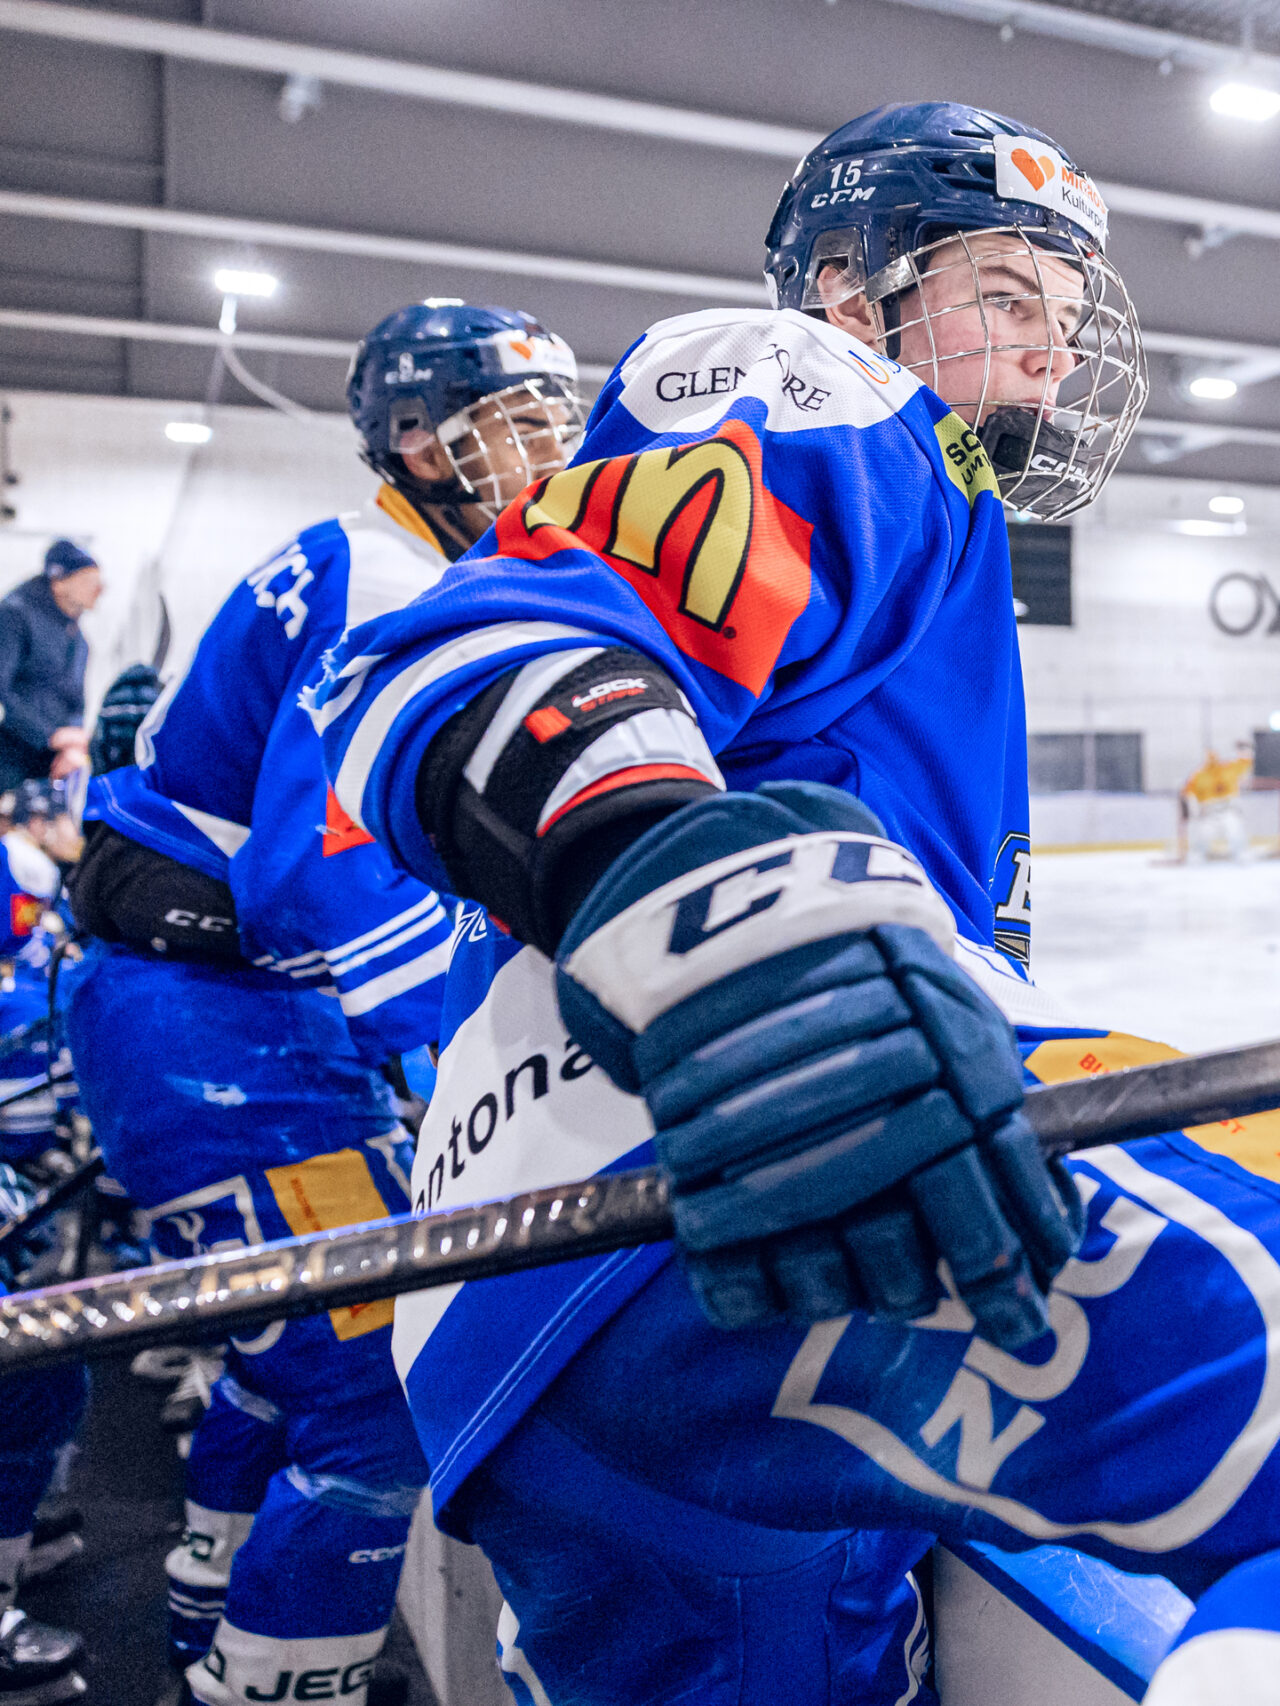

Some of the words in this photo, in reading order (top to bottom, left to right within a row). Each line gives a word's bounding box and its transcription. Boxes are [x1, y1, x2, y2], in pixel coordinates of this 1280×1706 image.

[830, 160, 864, 189] 15
[811, 186, 876, 208] CCM
[668, 842, 922, 955] CC
